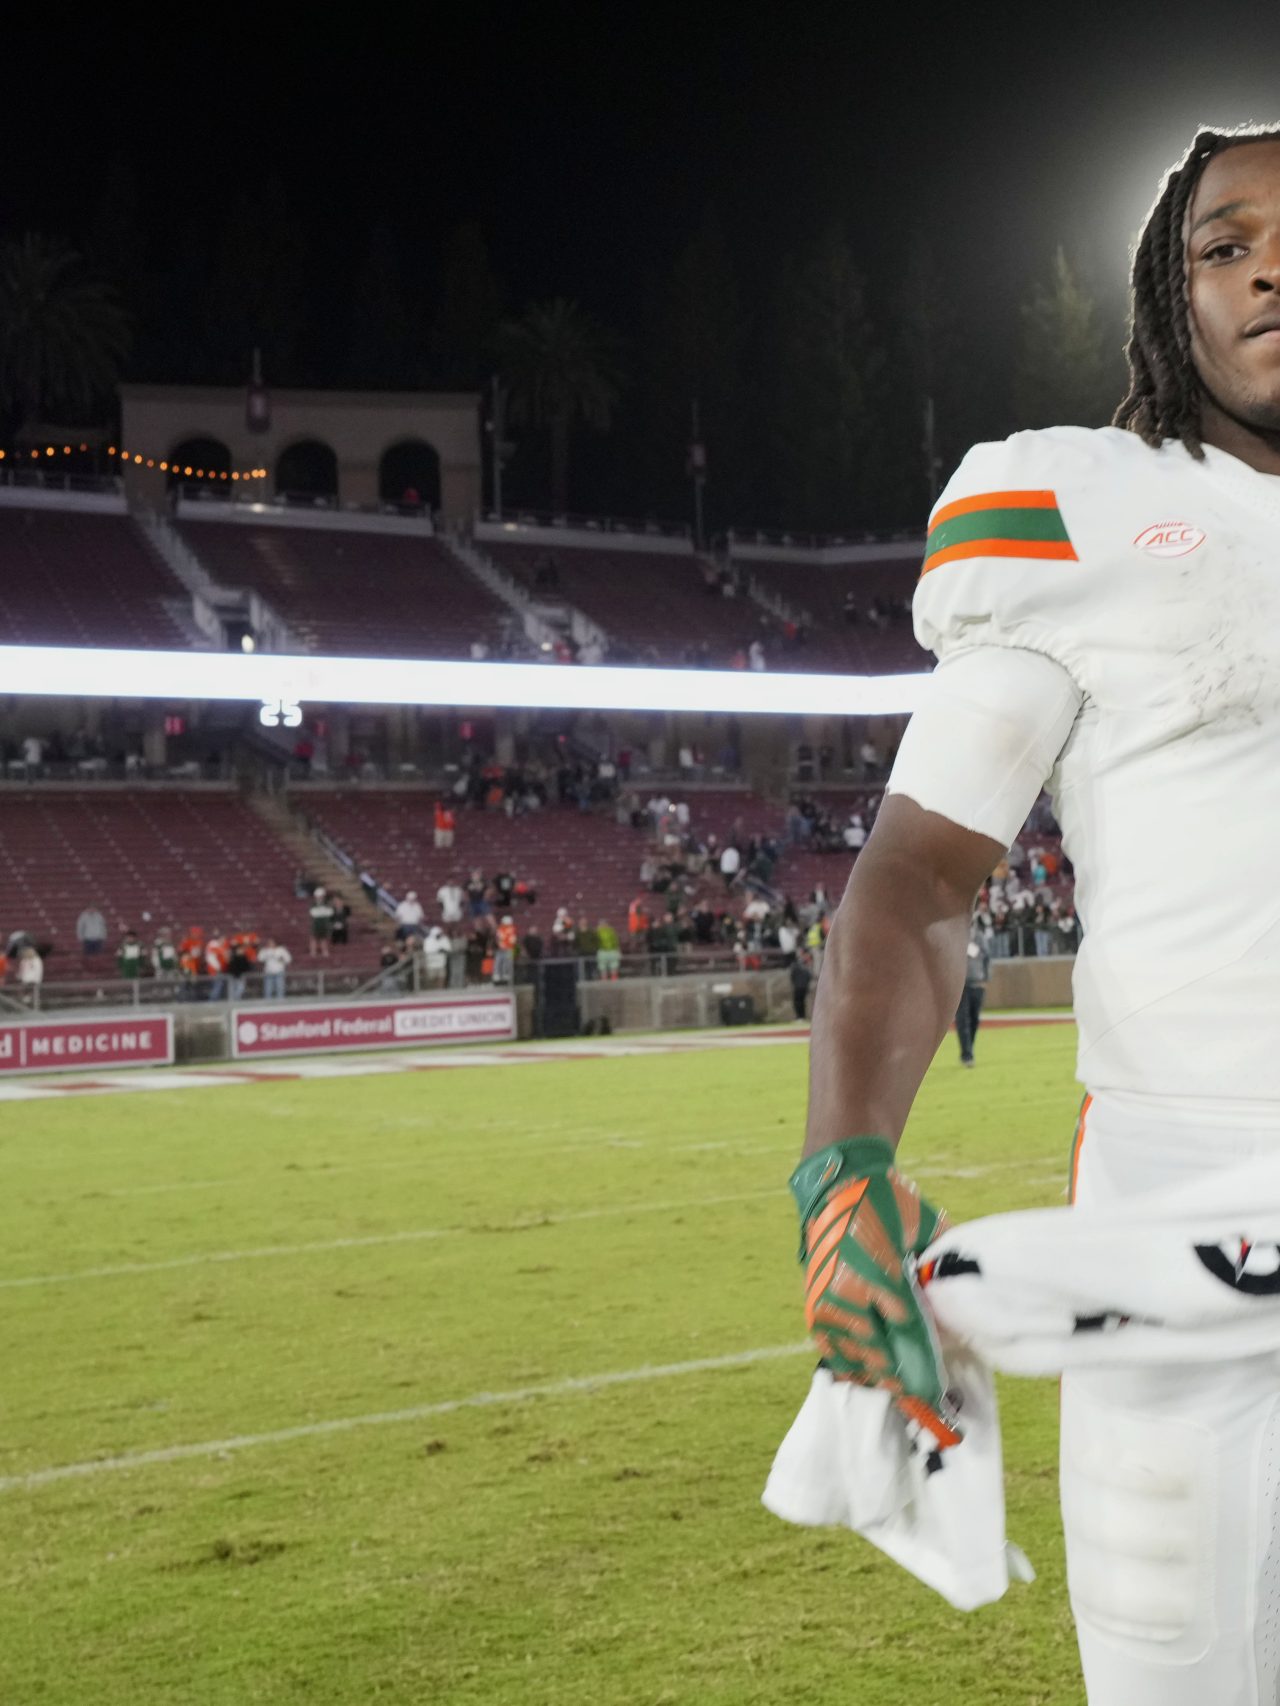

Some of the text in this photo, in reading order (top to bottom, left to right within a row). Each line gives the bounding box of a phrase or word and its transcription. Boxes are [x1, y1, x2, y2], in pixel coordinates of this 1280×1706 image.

[1146, 528, 1194, 545] ACC
[260, 1009, 507, 1041] Stanford Federal CREDIT UNION
[32, 1031, 152, 1056] MEDICINE
